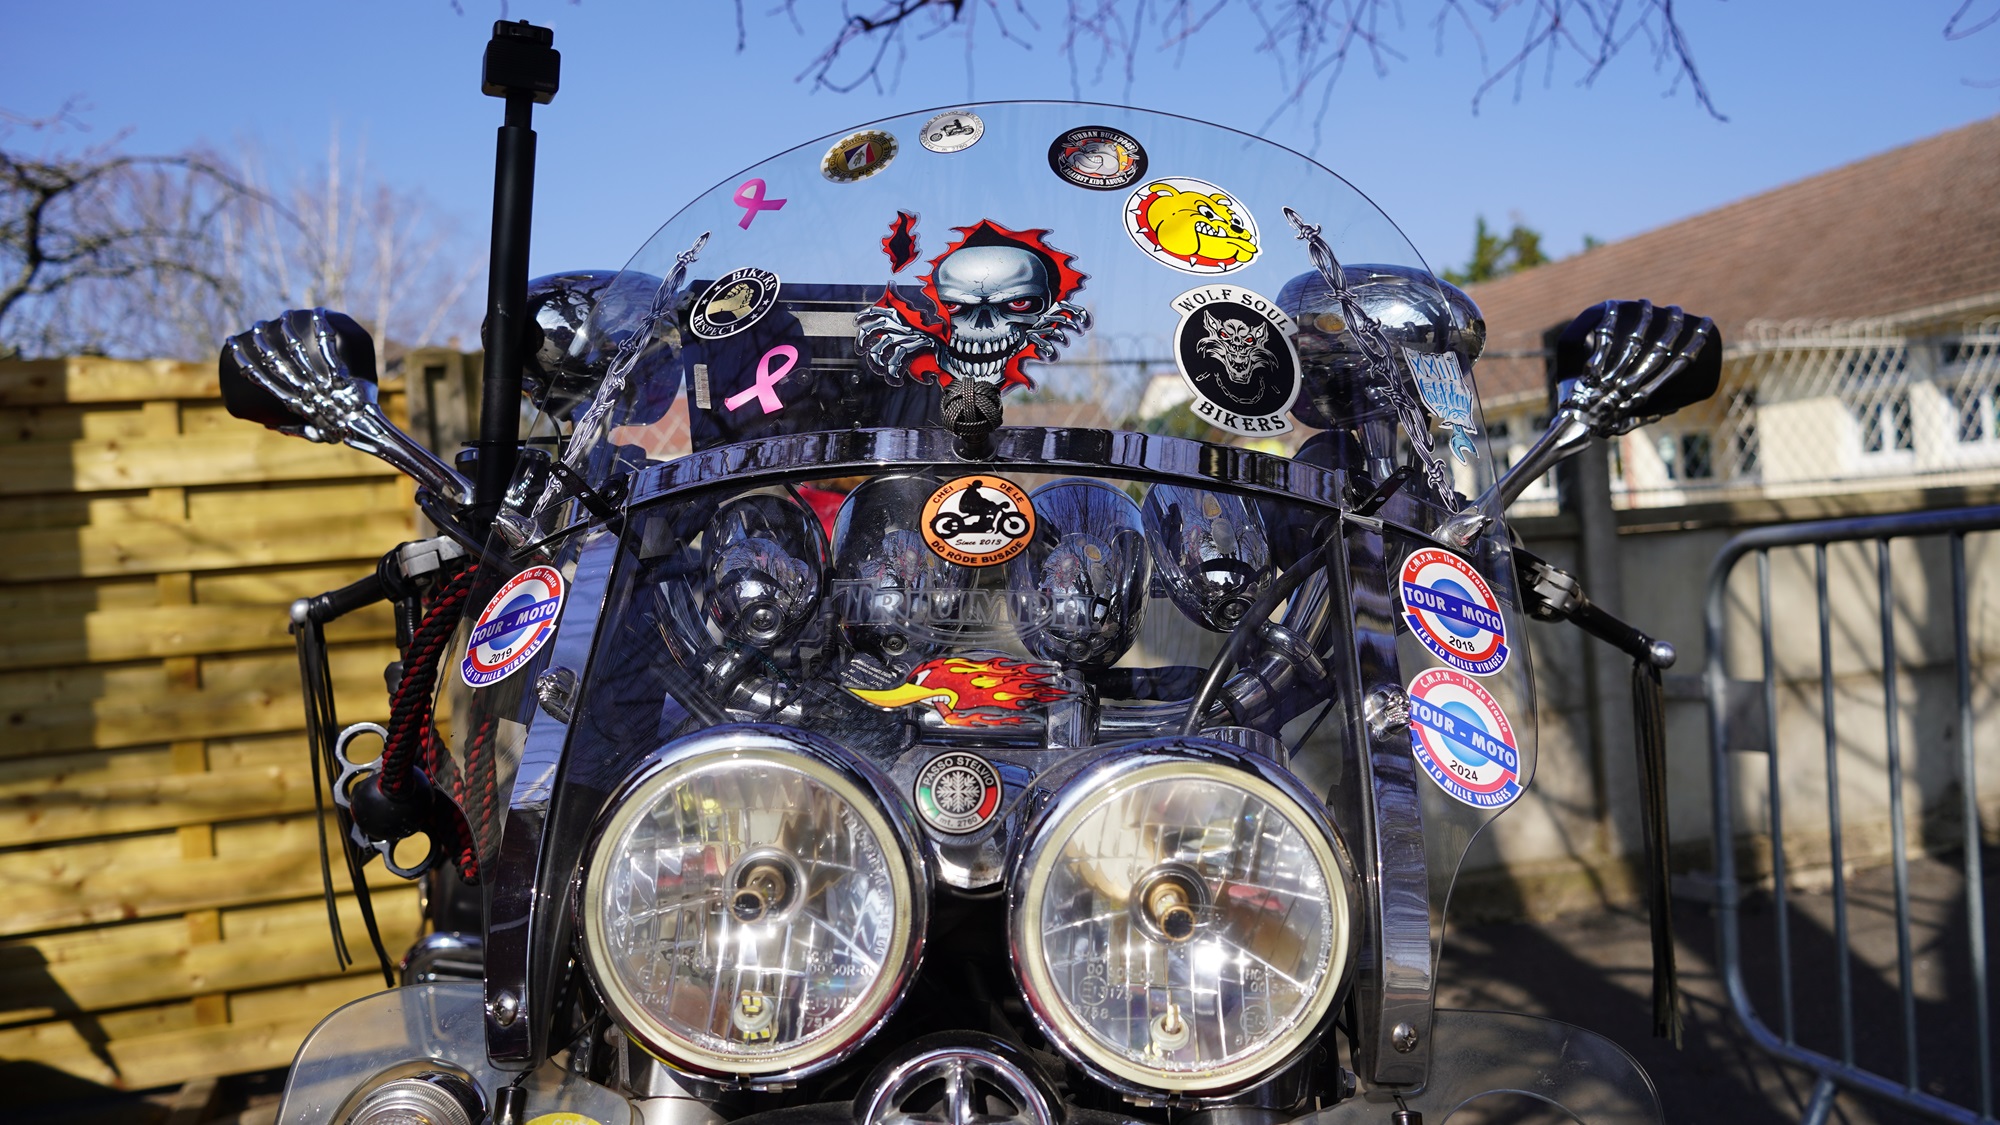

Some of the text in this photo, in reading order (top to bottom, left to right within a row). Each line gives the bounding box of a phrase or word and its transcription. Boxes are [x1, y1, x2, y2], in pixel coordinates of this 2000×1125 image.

[1072, 131, 1136, 150] URBAN BULLDOGS
[858, 147, 890, 175] NATIONALE
[1063, 166, 1127, 185] AGAINST KIDS ABUSE
[732, 268, 776, 291] BIKERS
[694, 313, 738, 336] RESPECT
[1178, 289, 1287, 331] WOLF SOUL
[1198, 400, 1286, 432] BIKERS
[999, 482, 1013, 492] DE
[1012, 491, 1025, 504] LE
[955, 538, 977, 546] Since
[981, 541, 1024, 564] BUSADE
[486, 582, 516, 613] C.M.P.N.
[523, 571, 533, 580] Ile
[534, 568, 543, 577] de
[542, 569, 557, 589] France
[1408, 552, 1437, 573] C.M.P.N.
[1443, 554, 1455, 565] Ile
[1456, 561, 1467, 572] de
[1468, 569, 1491, 600] France
[472, 620, 505, 645] TOUR
[515, 601, 557, 627] MOTO
[1404, 586, 1447, 612] TOUR
[1462, 604, 1502, 631] MOTO
[488, 646, 513, 665] 2019
[1416, 627, 1503, 673] LES 10 MILLE VIRAGES
[1448, 635, 1475, 653] 2018
[464, 639, 541, 683] LES 10 MILLE VIRAGES
[1420, 671, 1454, 688] C.M.P.N.
[1462, 677, 1474, 690] Ile
[1475, 688, 1487, 700] de
[1487, 699, 1509, 733] France
[1411, 700, 1455, 735] TOUR
[1471, 731, 1516, 768] MOTO
[922, 756, 994, 787] PASSO STELVIO
[1415, 744, 1512, 806] LES 10 MILLE VIRAGES
[1449, 759, 1479, 782] 2024
[940, 816, 978, 828] mt. 2760
